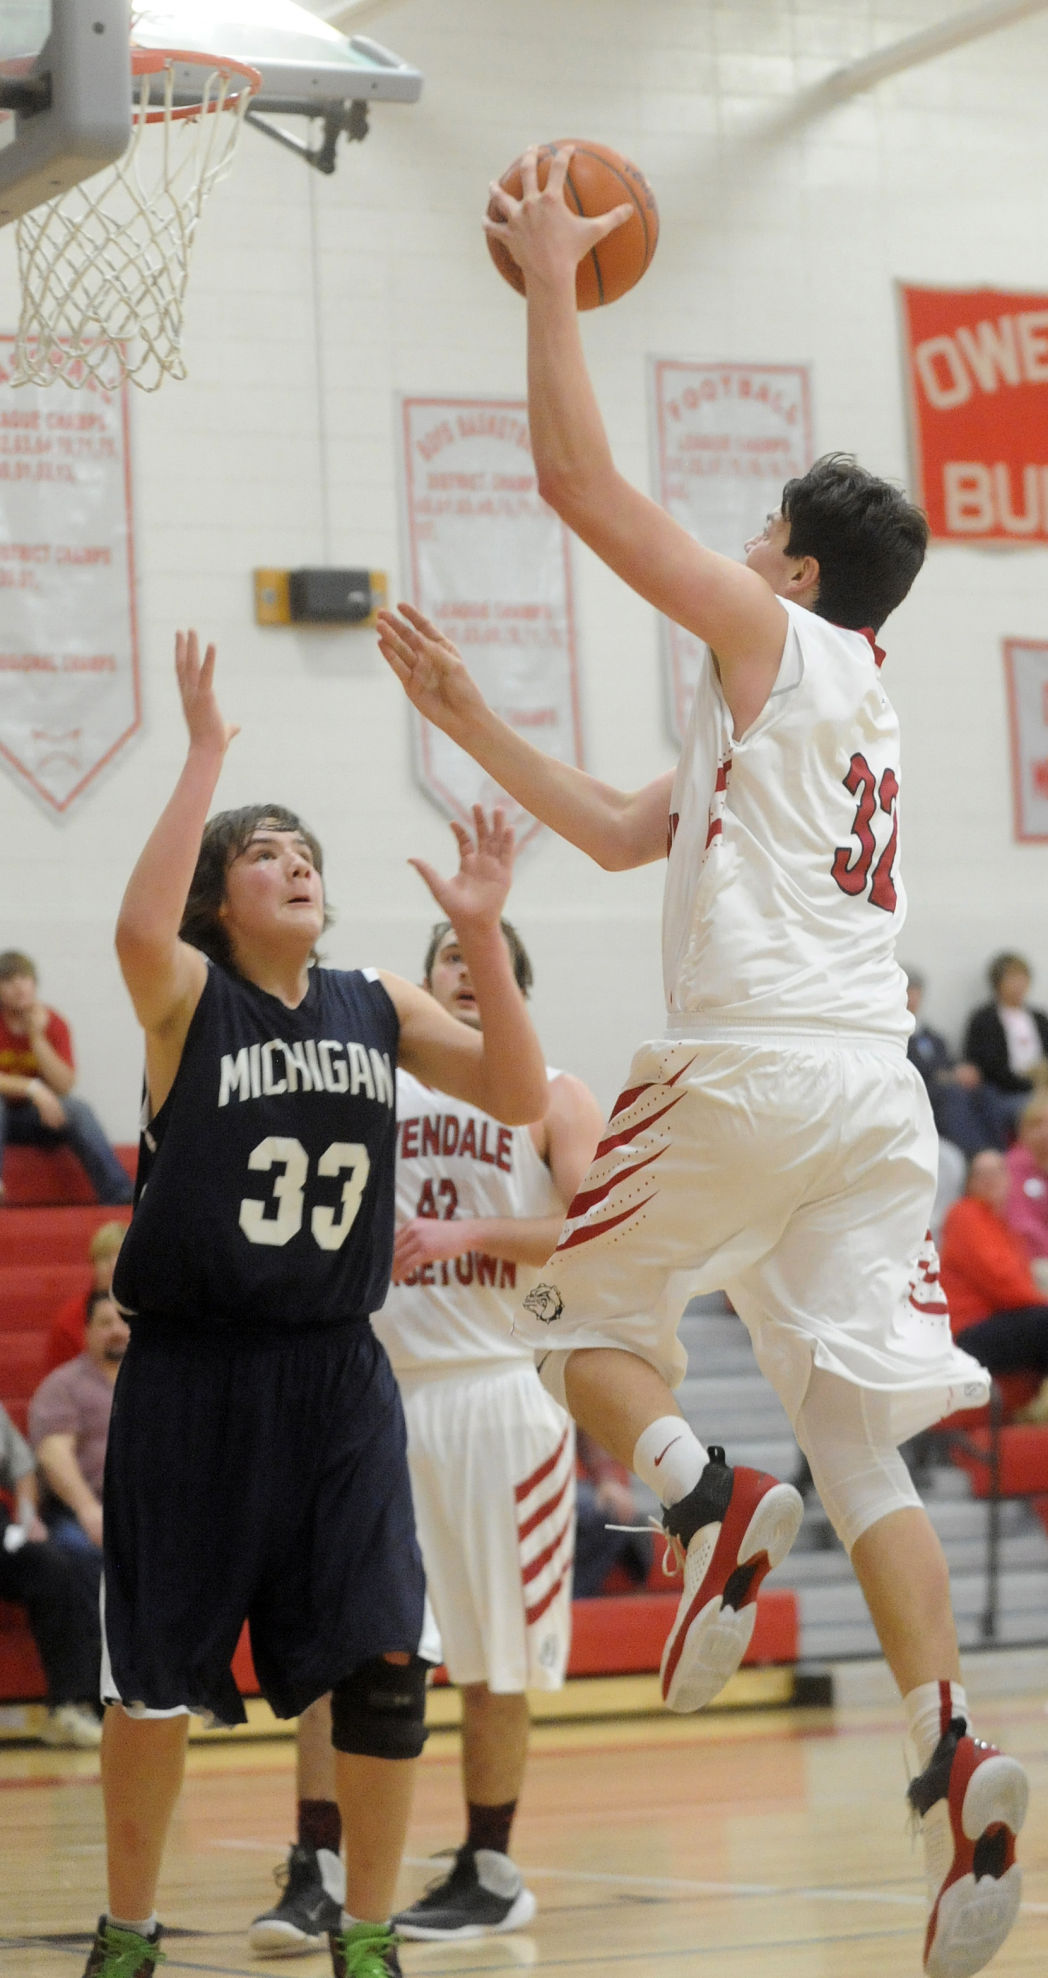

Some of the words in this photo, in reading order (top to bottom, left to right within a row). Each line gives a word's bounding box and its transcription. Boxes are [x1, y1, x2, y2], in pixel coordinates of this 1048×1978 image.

[943, 461, 1048, 534] BU
[830, 752, 899, 914] 32
[218, 1038, 394, 1108] MICHIGAN
[238, 1136, 370, 1251] 33
[417, 1178, 458, 1221] 42
